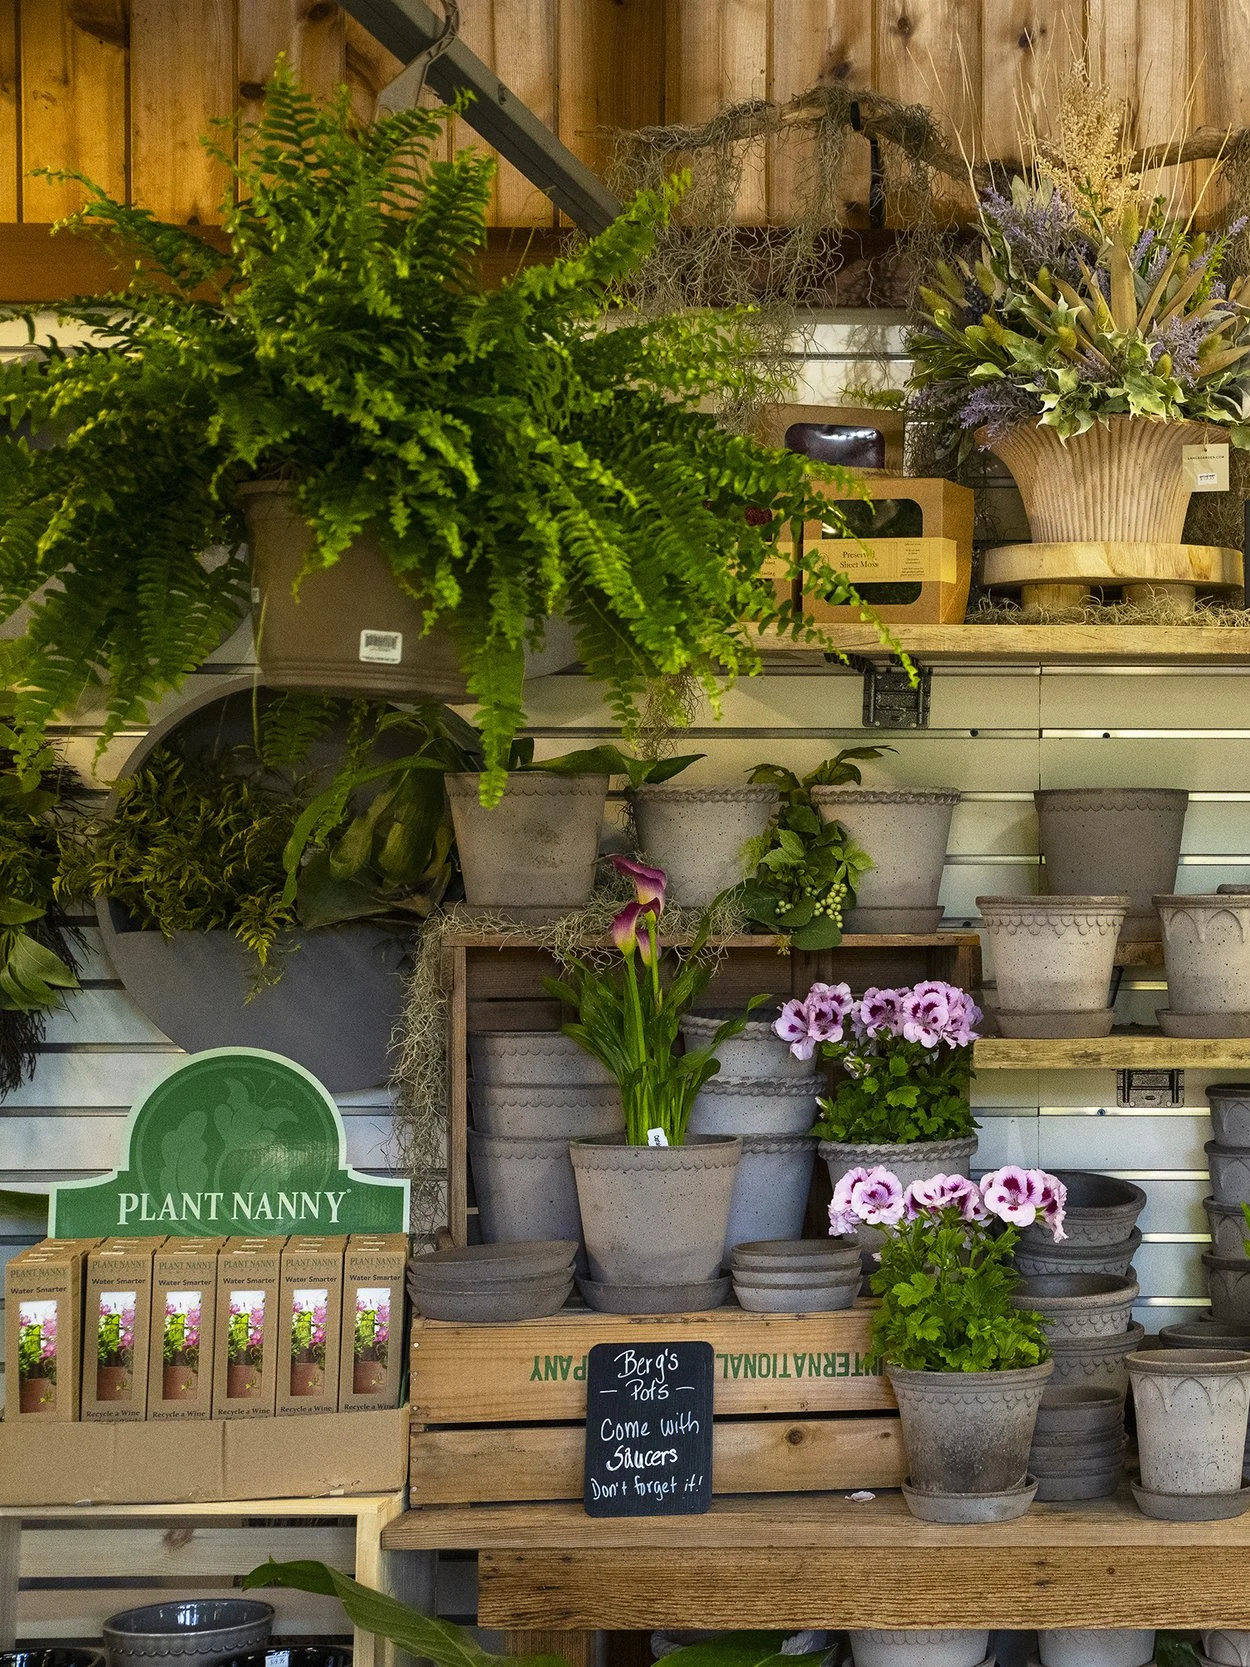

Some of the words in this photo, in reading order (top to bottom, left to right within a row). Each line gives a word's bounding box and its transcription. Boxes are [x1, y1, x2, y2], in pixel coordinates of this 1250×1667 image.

[842, 550, 875, 558] Preservd
[860, 560, 878, 568] Moss
[117, 1192, 224, 1225] PLANT
[231, 1191, 347, 1223] NANNY
[92, 1261, 118, 1269] PLANT
[119, 1260, 146, 1268] NANNY
[159, 1262, 185, 1270] PLANT
[186, 1261, 213, 1269] NANNY
[224, 1260, 249, 1268] PLANT
[250, 1259, 276, 1268] NANNY
[286, 1259, 310, 1267] PLANT
[311, 1258, 338, 1267] NANNY
[350, 1257, 375, 1265] PLANT
[376, 1257, 400, 1265] NANNY
[10, 1269, 37, 1278] PLANT
[38, 1268, 67, 1277] NANNY
[614, 1349, 678, 1383] Berg's
[625, 1378, 669, 1401] Pots
[600, 1418, 650, 1441] Come
[660, 1411, 699, 1436] with
[606, 1445, 678, 1471] Saucers
[590, 1478, 627, 1500] Don't
[634, 1475, 677, 1501] forget
[684, 1474, 703, 1492] it!
